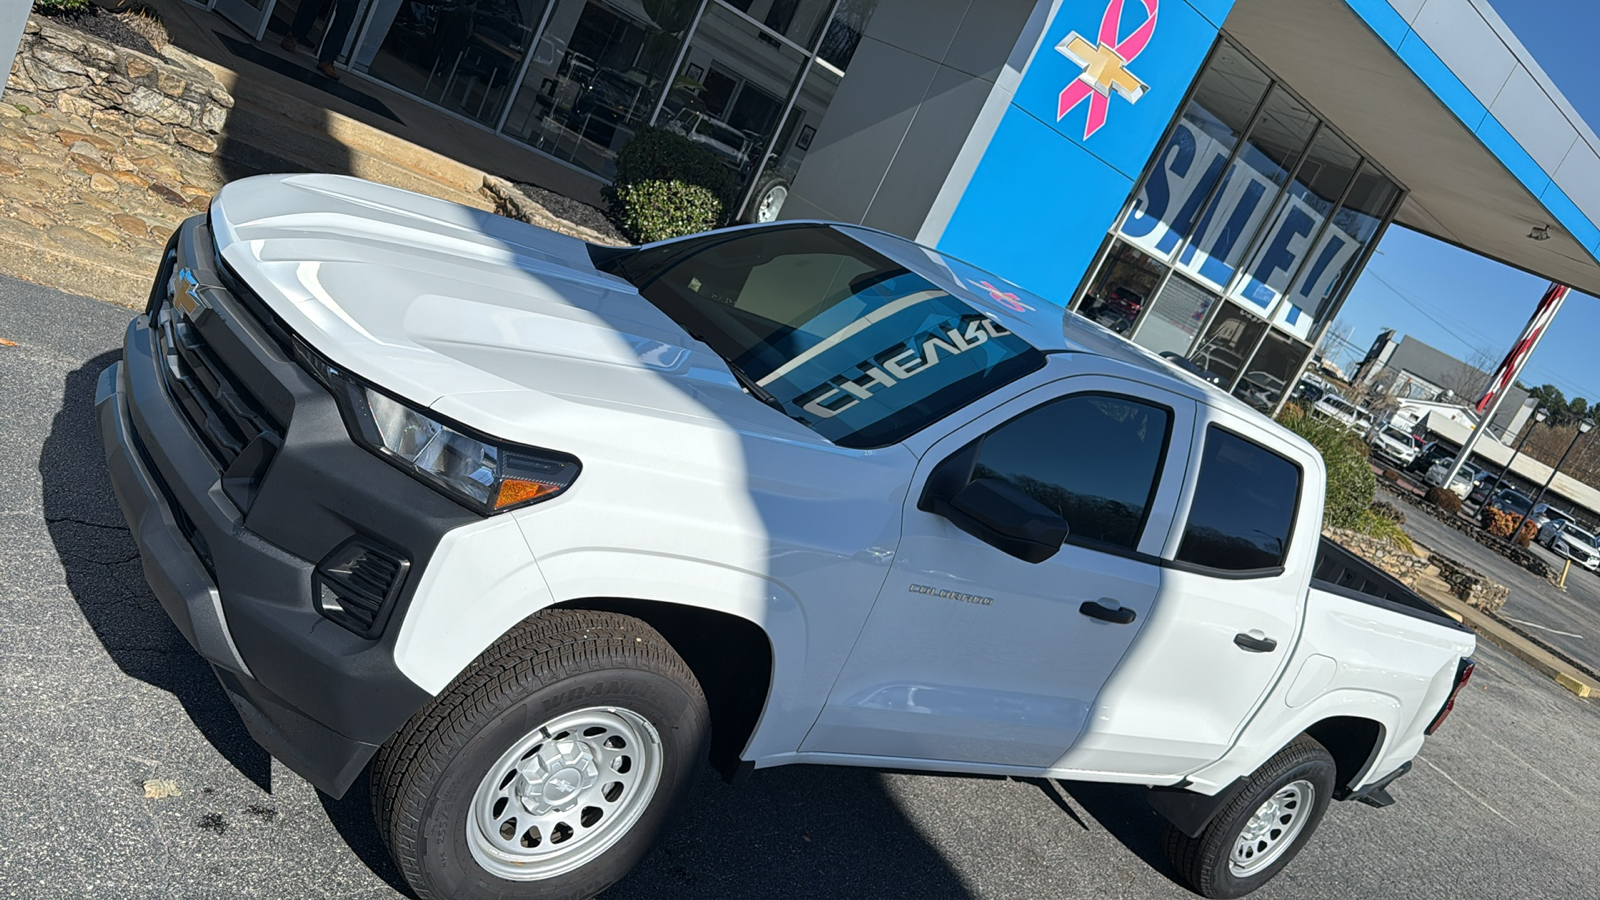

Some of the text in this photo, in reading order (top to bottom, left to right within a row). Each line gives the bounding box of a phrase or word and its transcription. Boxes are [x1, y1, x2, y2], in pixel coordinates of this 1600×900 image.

[1121, 124, 1346, 327] SALE!
[908, 584, 994, 605] COLORADO
[542, 681, 683, 712] WRANG
